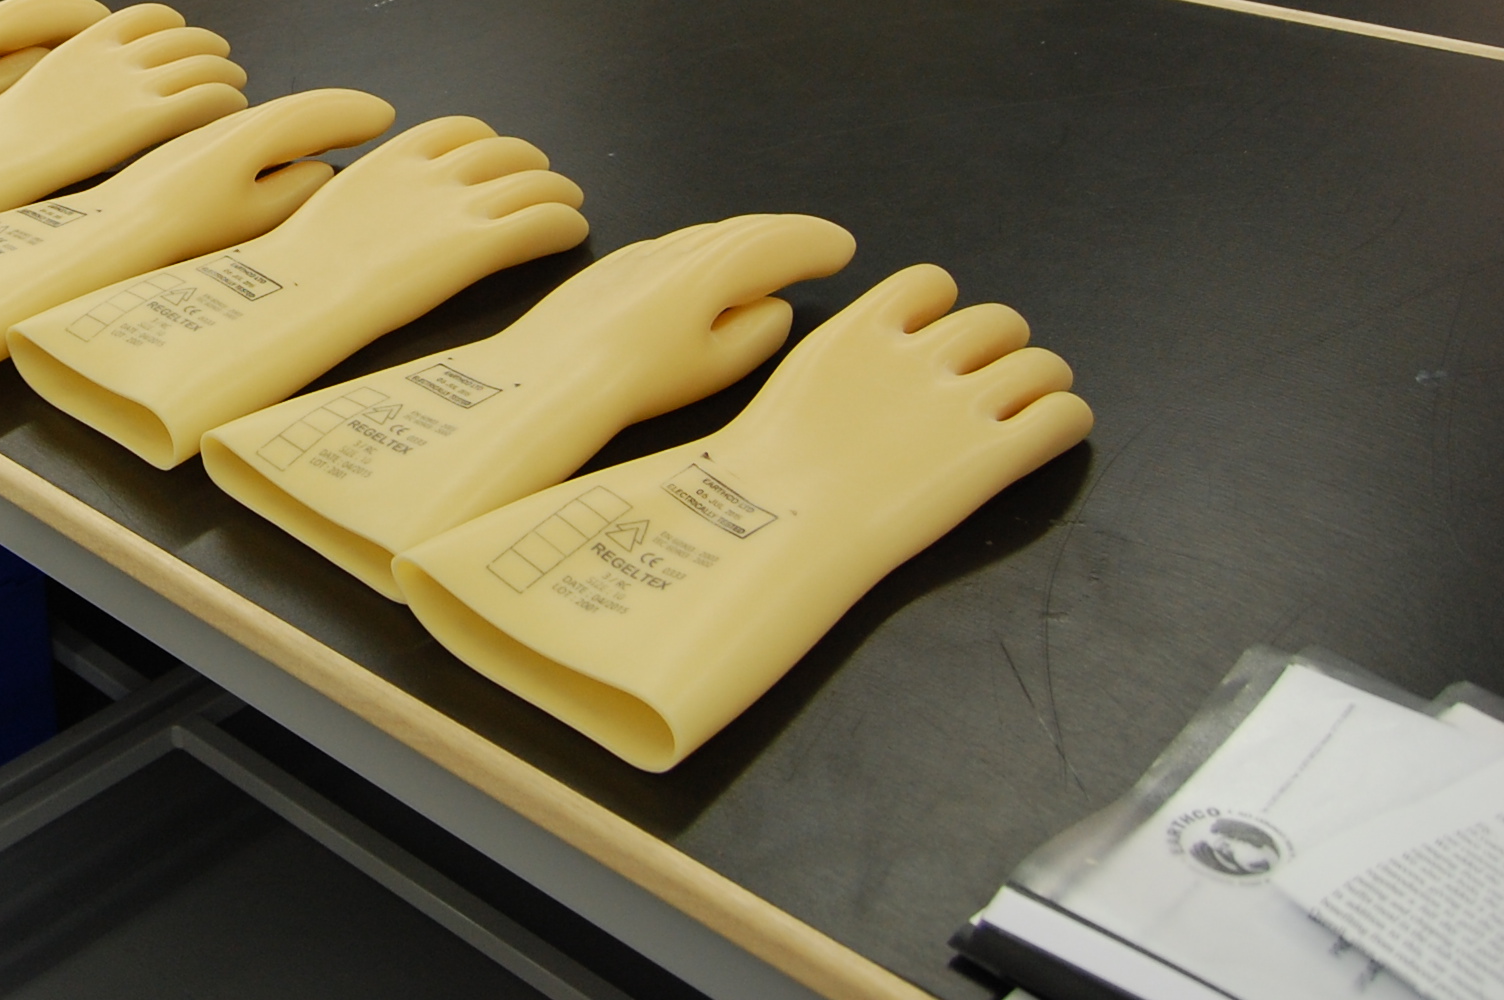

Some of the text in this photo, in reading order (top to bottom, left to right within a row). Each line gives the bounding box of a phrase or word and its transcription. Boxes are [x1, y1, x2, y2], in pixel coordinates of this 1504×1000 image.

[147, 301, 203, 332] REGELTEX
[347, 419, 413, 455] REGELTEX
[666, 483, 746, 534] ELECTRICALLY TESTED
[738, 501, 755, 513] LTD
[591, 541, 672, 590] REGELTEX
